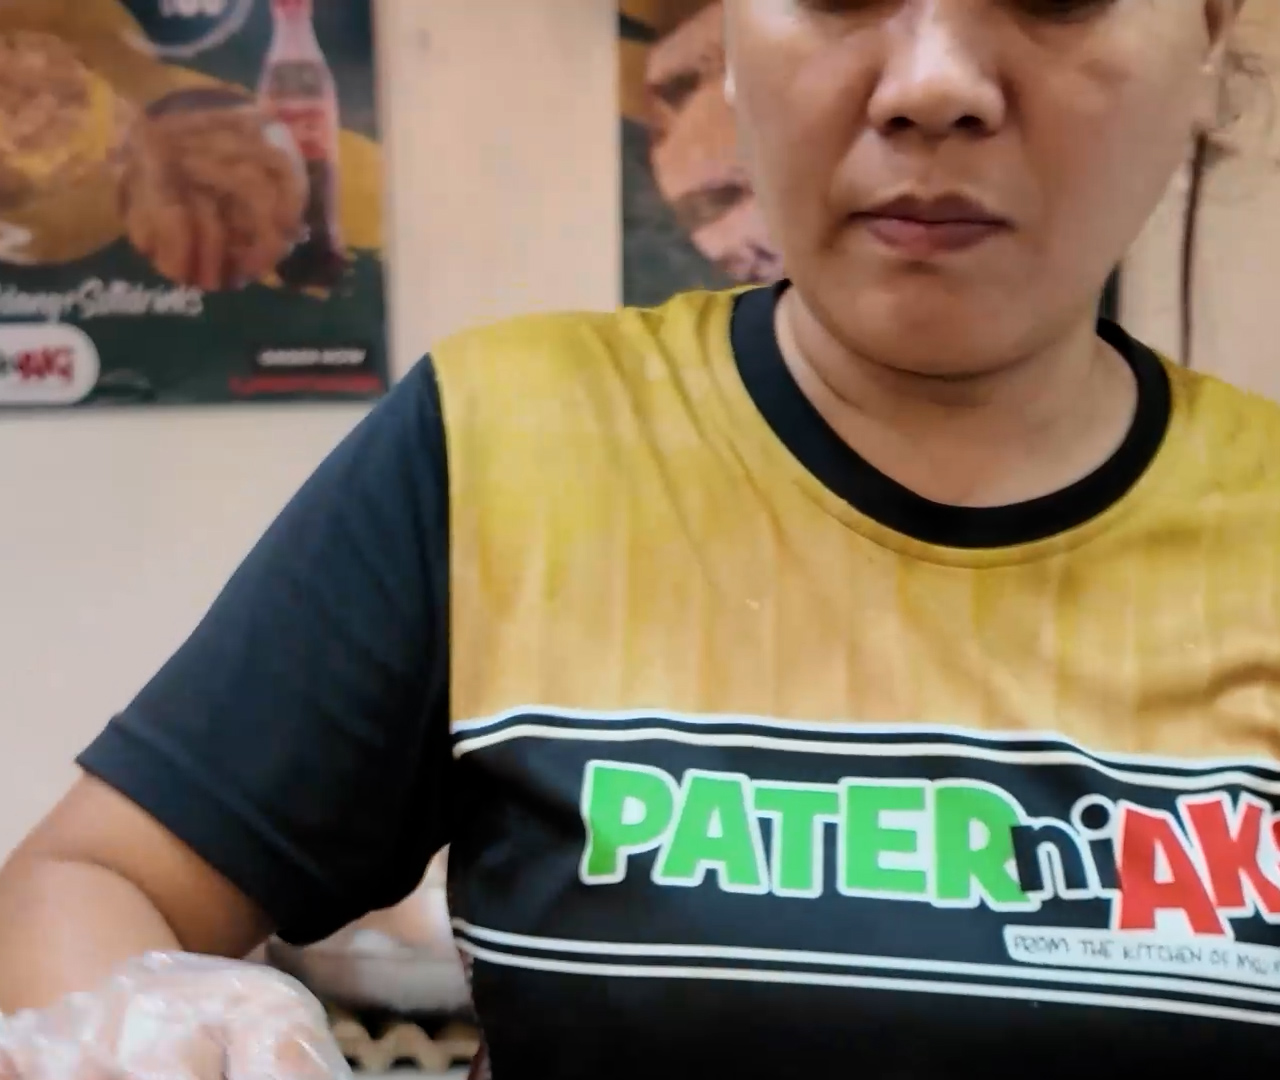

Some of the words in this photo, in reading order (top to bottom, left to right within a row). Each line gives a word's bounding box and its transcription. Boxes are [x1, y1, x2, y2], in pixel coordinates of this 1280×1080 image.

[1013, 935, 1070, 954] FROM
[1078, 939, 1114, 959] THE
[1122, 942, 1203, 964] KITCHEN
